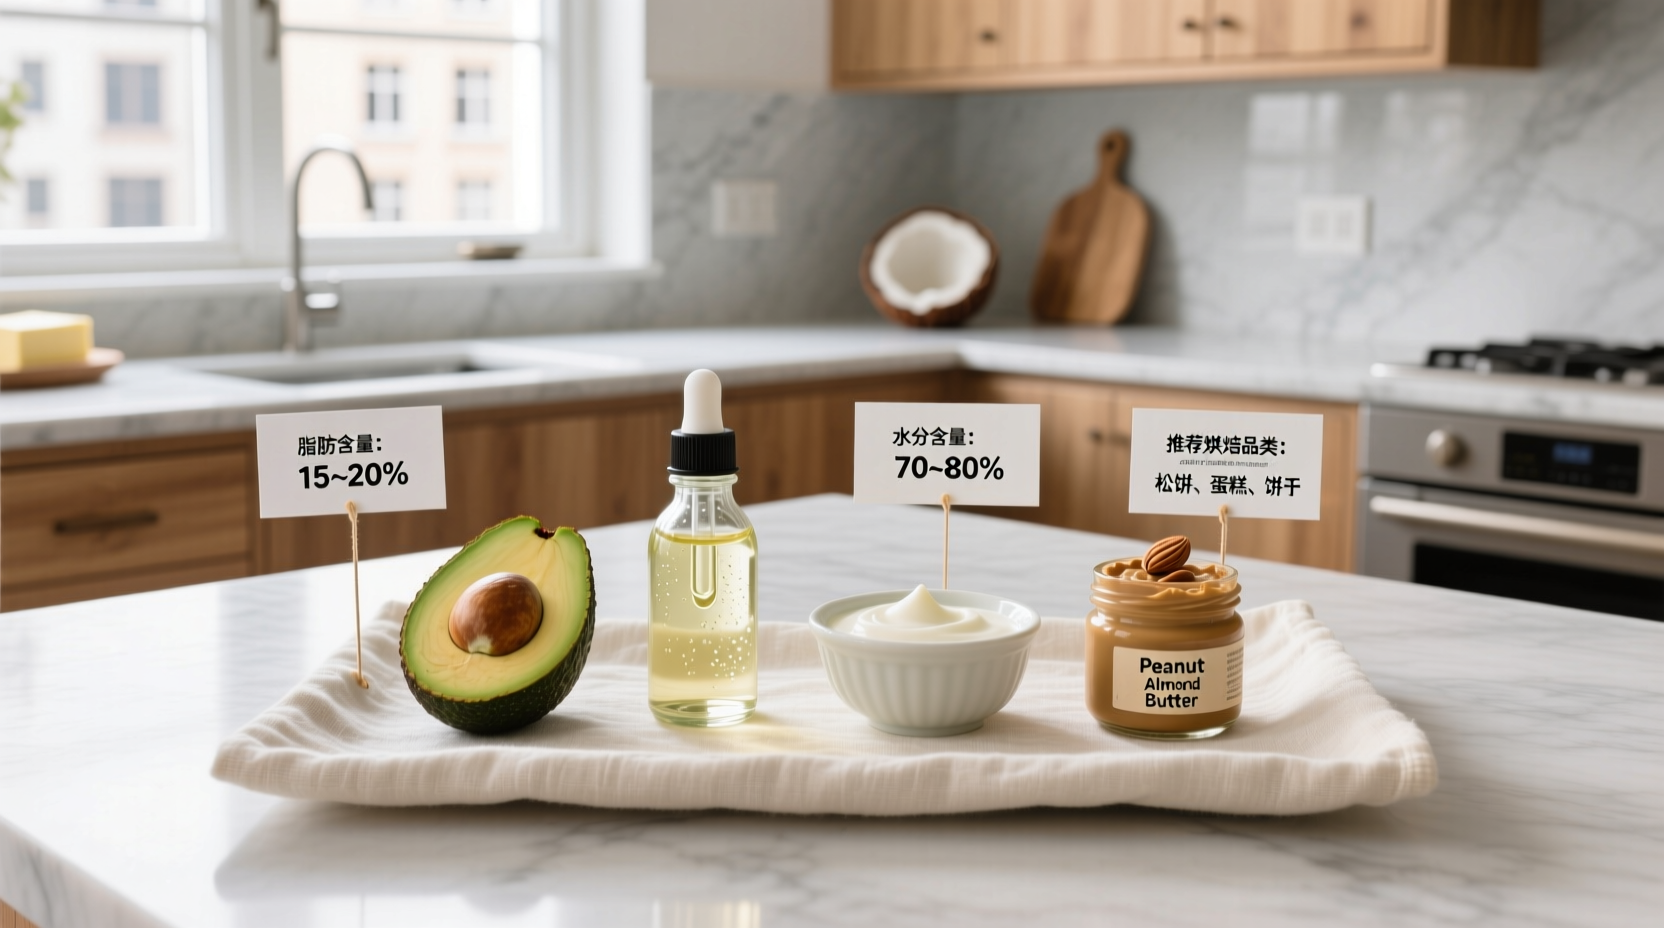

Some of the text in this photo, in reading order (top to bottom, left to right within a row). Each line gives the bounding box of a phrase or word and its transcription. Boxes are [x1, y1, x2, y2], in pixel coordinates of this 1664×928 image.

[298, 461, 409, 489] 15~20%
[895, 456, 1004, 480] 70~80%
[1140, 657, 1205, 674] Peanut
[1144, 677, 1200, 691] Almond
[1145, 693, 1198, 708] Butter
